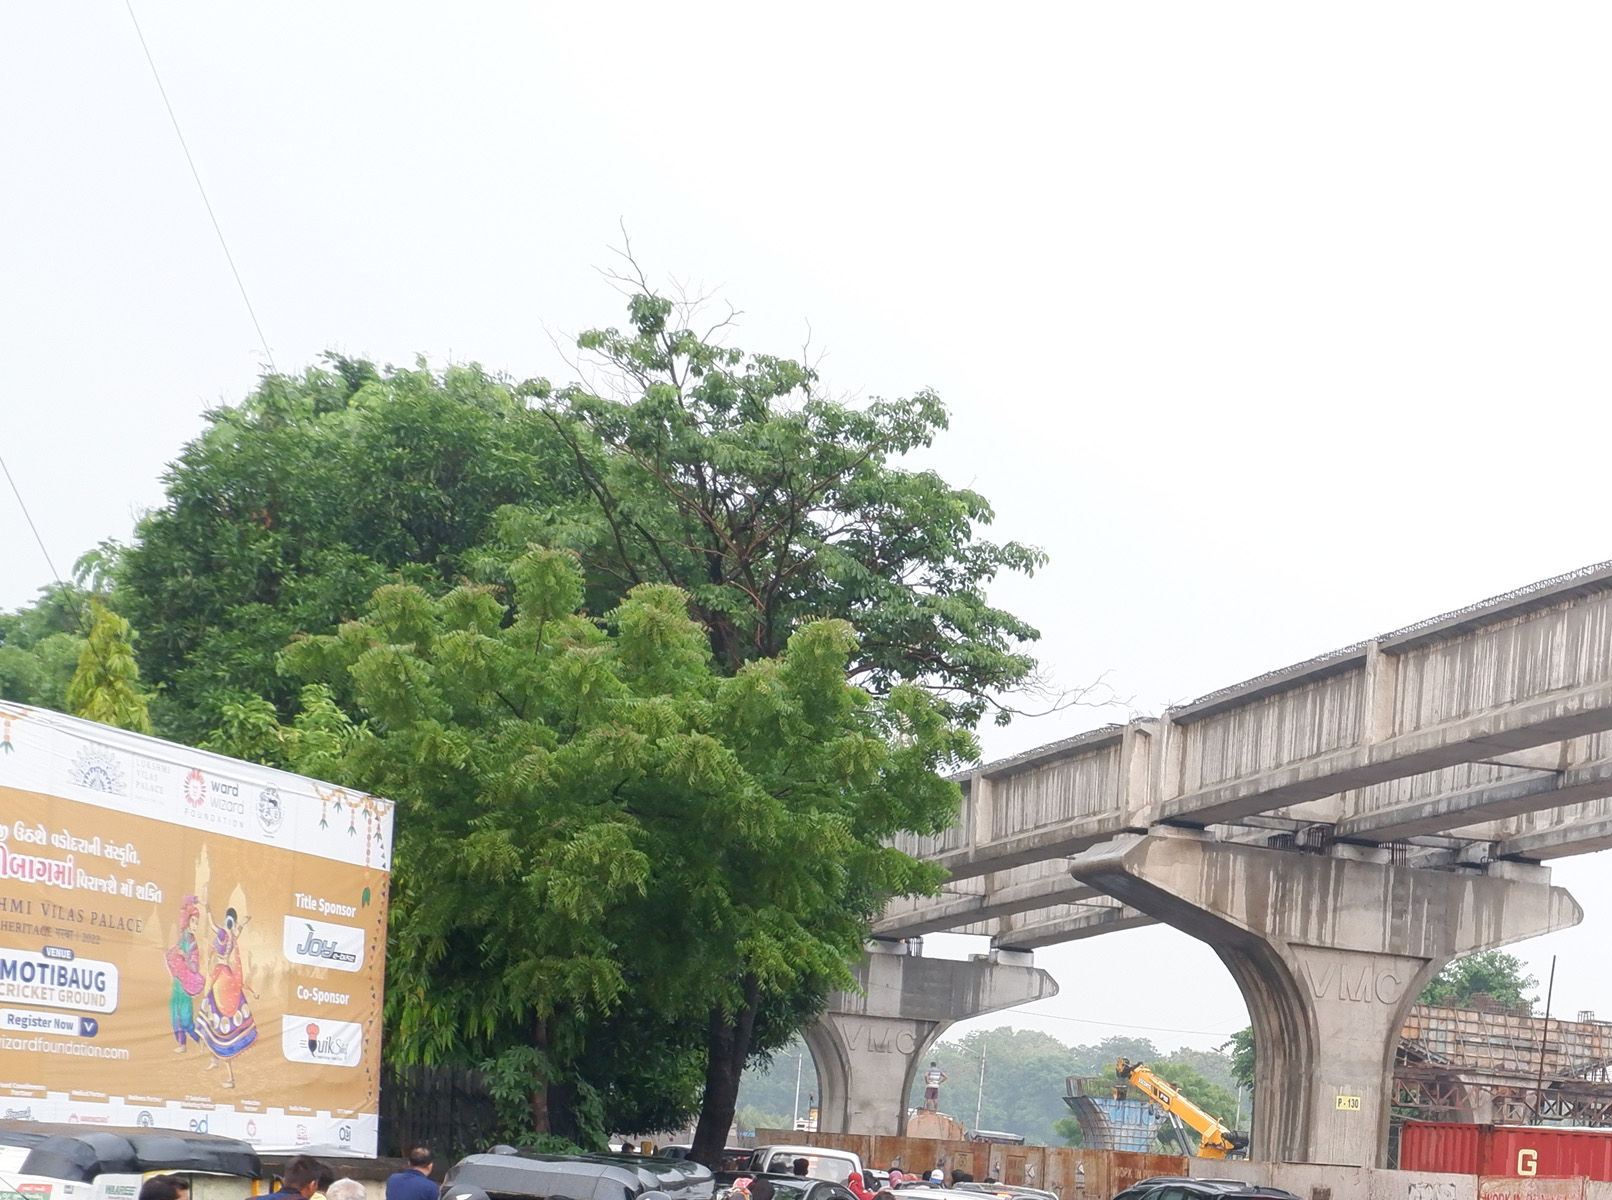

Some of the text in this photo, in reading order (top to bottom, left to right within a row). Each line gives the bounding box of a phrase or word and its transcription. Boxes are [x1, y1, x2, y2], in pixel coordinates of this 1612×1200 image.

[211, 780, 239, 797] ward
[184, 807, 245, 828] FOUNDATION
[210, 796, 245, 815] wizard
[41, 902, 85, 923] VILAS
[90, 911, 142, 934] PALACE
[294, 892, 357, 918] Title Sponsor
[1, 920, 52, 938] HERITAGE
[45, 946, 72, 959] VENUE
[296, 929, 338, 959] Joy
[0, 958, 106, 992] MOTIBAUG
[1304, 958, 1402, 1005] VMC
[0, 981, 106, 1007] CRICKET GROUND
[296, 985, 350, 1005] Co-Sponsor
[7, 1013, 74, 1031] Register Now
[842, 1023, 917, 1056] VMC
[1516, 1148, 1538, 1177] G
